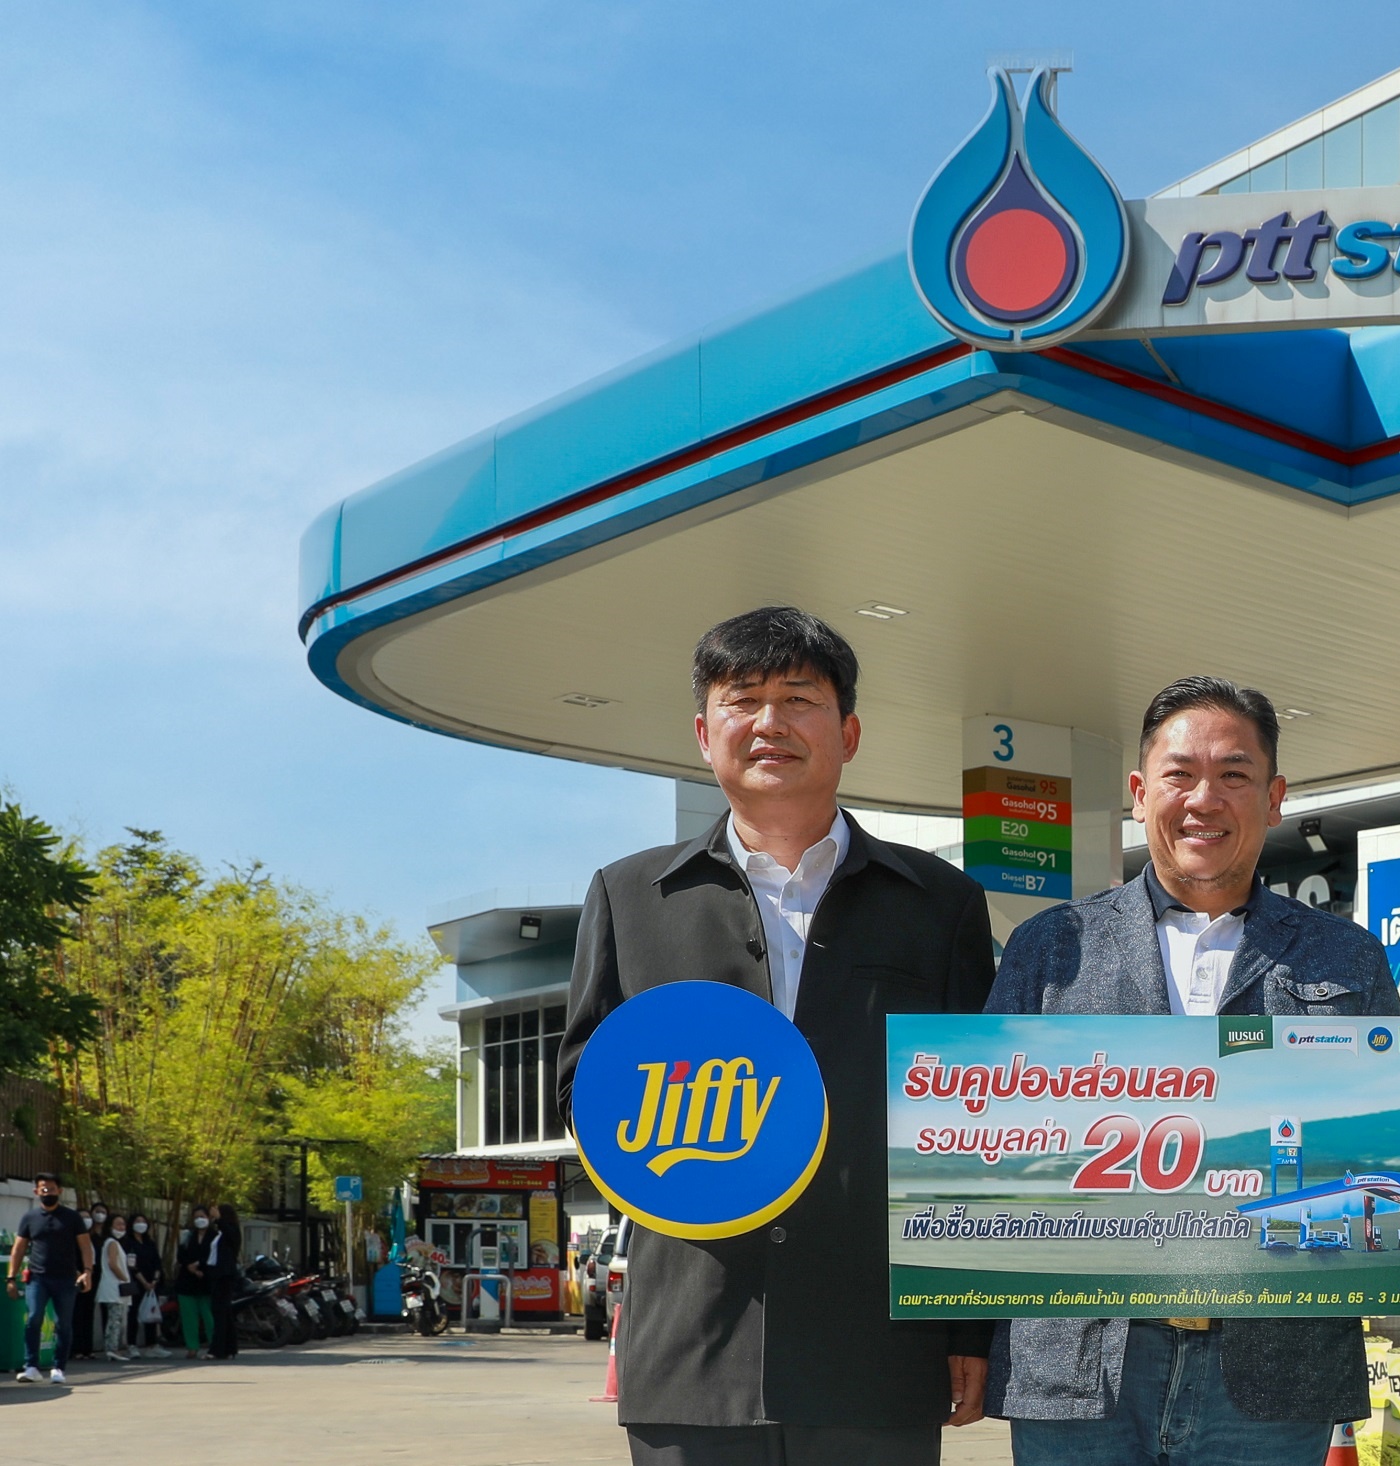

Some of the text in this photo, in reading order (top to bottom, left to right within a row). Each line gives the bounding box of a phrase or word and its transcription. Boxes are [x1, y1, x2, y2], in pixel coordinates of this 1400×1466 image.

[993, 724, 1014, 762] 3
[1006, 780, 1058, 796] Gasohol 95
[1001, 797, 1058, 821] Gasohol 95
[1001, 821, 1029, 838] E20
[1001, 847, 1057, 868] Gasohol 91
[1001, 872, 1025, 883] Diesel
[1025, 875, 1046, 892] B7
[1314, 1034, 1353, 1044] station
[1371, 1034, 1389, 1047] Jiffy
[904, 1053, 1217, 1115] รับคูปองส่วนลด
[616, 1056, 782, 1178] Jiffy
[917, 1114, 1264, 1194] รวมมูลค่า 20 บาท
[1257, 1288, 1292, 1304] ตั้งแต่
[1296, 1292, 1313, 1304] 24
[1347, 1291, 1364, 1304] 65
[1378, 1291, 1386, 1304] 3
